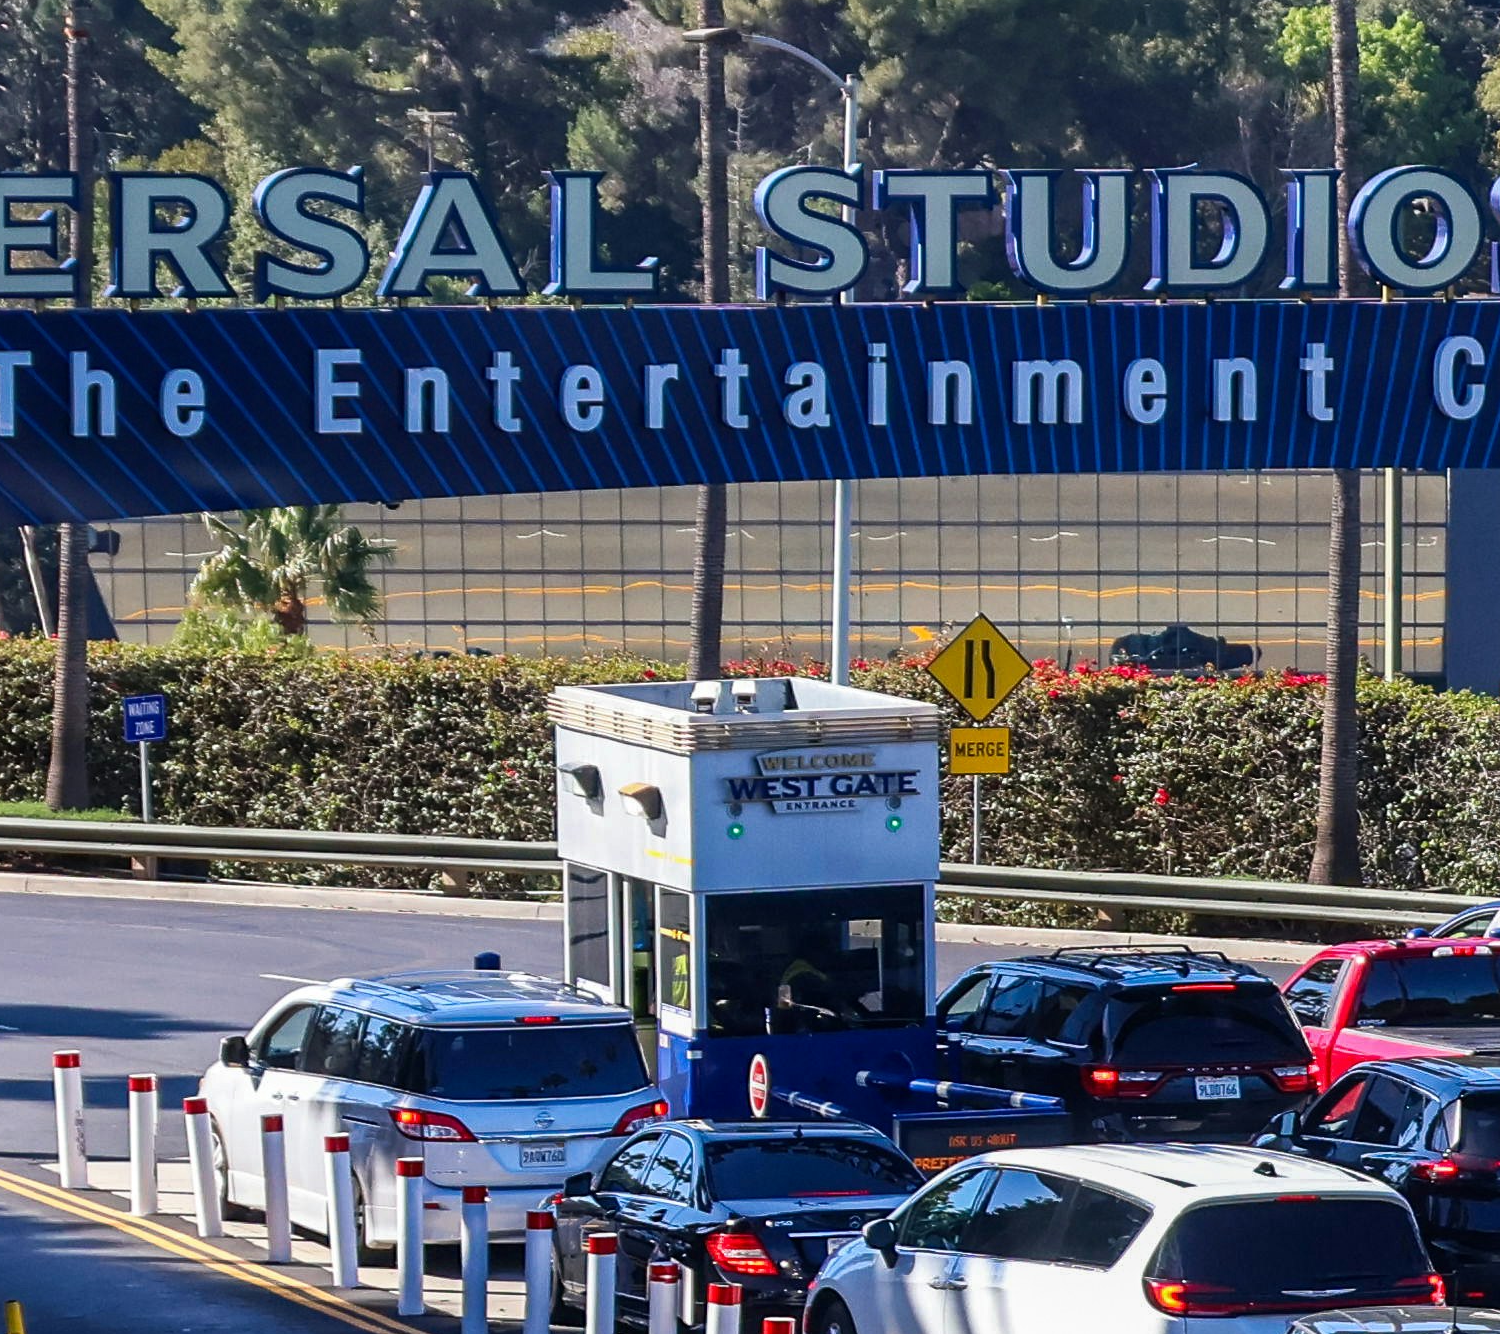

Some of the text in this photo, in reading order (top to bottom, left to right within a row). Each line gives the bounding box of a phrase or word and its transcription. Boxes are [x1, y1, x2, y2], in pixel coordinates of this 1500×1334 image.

[313, 342, 1336, 435] Entertainment
[955, 742, 1005, 757] MERGE
[762, 752, 876, 770] WELCOME
[729, 771, 918, 800] WEST GATE
[786, 799, 855, 811] ENTRANCE
[987, 1133, 1017, 1146] ABOUT
